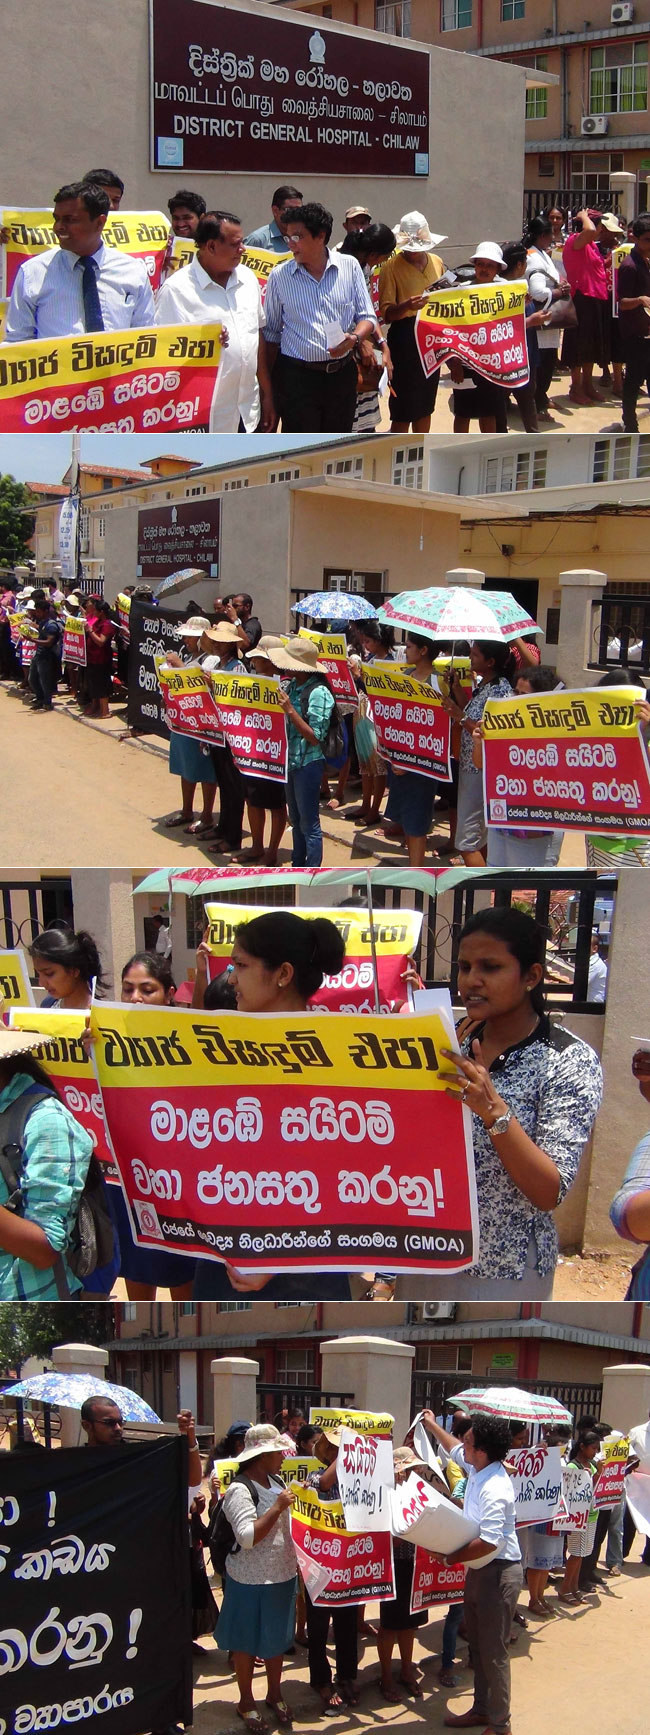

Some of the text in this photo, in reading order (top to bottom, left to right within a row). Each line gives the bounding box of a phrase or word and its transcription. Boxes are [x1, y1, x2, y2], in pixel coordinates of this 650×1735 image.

[260, 59, 289, 83] මහ
[295, 66, 349, 97] රෝහල
[363, 79, 412, 102] හලාවත
[155, 81, 226, 106] மாவட்டப்
[231, 85, 274, 117] பொது
[390, 106, 427, 127] சிலாபம்
[174, 115, 244, 138] DISTRICT
[250, 121, 312, 143] GENERAL
[318, 127, 372, 147] HOSPITAL
[383, 133, 420, 150] CHILAW
[137, 223, 168, 242] එපා
[72, 334, 157, 372] විසඳුම්
[168, 336, 215, 359] එපා
[24, 386, 105, 425] මාළඹේ
[113, 370, 180, 404] සයිටම්
[140, 555, 155, 564] DISTRICT
[155, 554, 172, 563] GENERAL
[173, 553, 192, 563] HOSPITAL
[484, 701, 634, 731] ව්‍යාජ විසඳුම් එපා
[508, 743, 617, 770] මාළඹේ සයිටම්
[495, 774, 642, 809] වහා ජනසතු කරනු!
[99, 1024, 440, 1074] ව්‍යාජ විසඳුම් එපා
[150, 1096, 395, 1149] මාළඹේ සයිටම්
[130, 1158, 445, 1218] වහා ජනසතු කරනු!
[162, 1221, 196, 1237] රජයේ
[238, 1229, 331, 1252] නිලධාරීන්ගේ
[337, 1231, 398, 1248] සංගමය
[404, 1234, 465, 1255] (GMOA)
